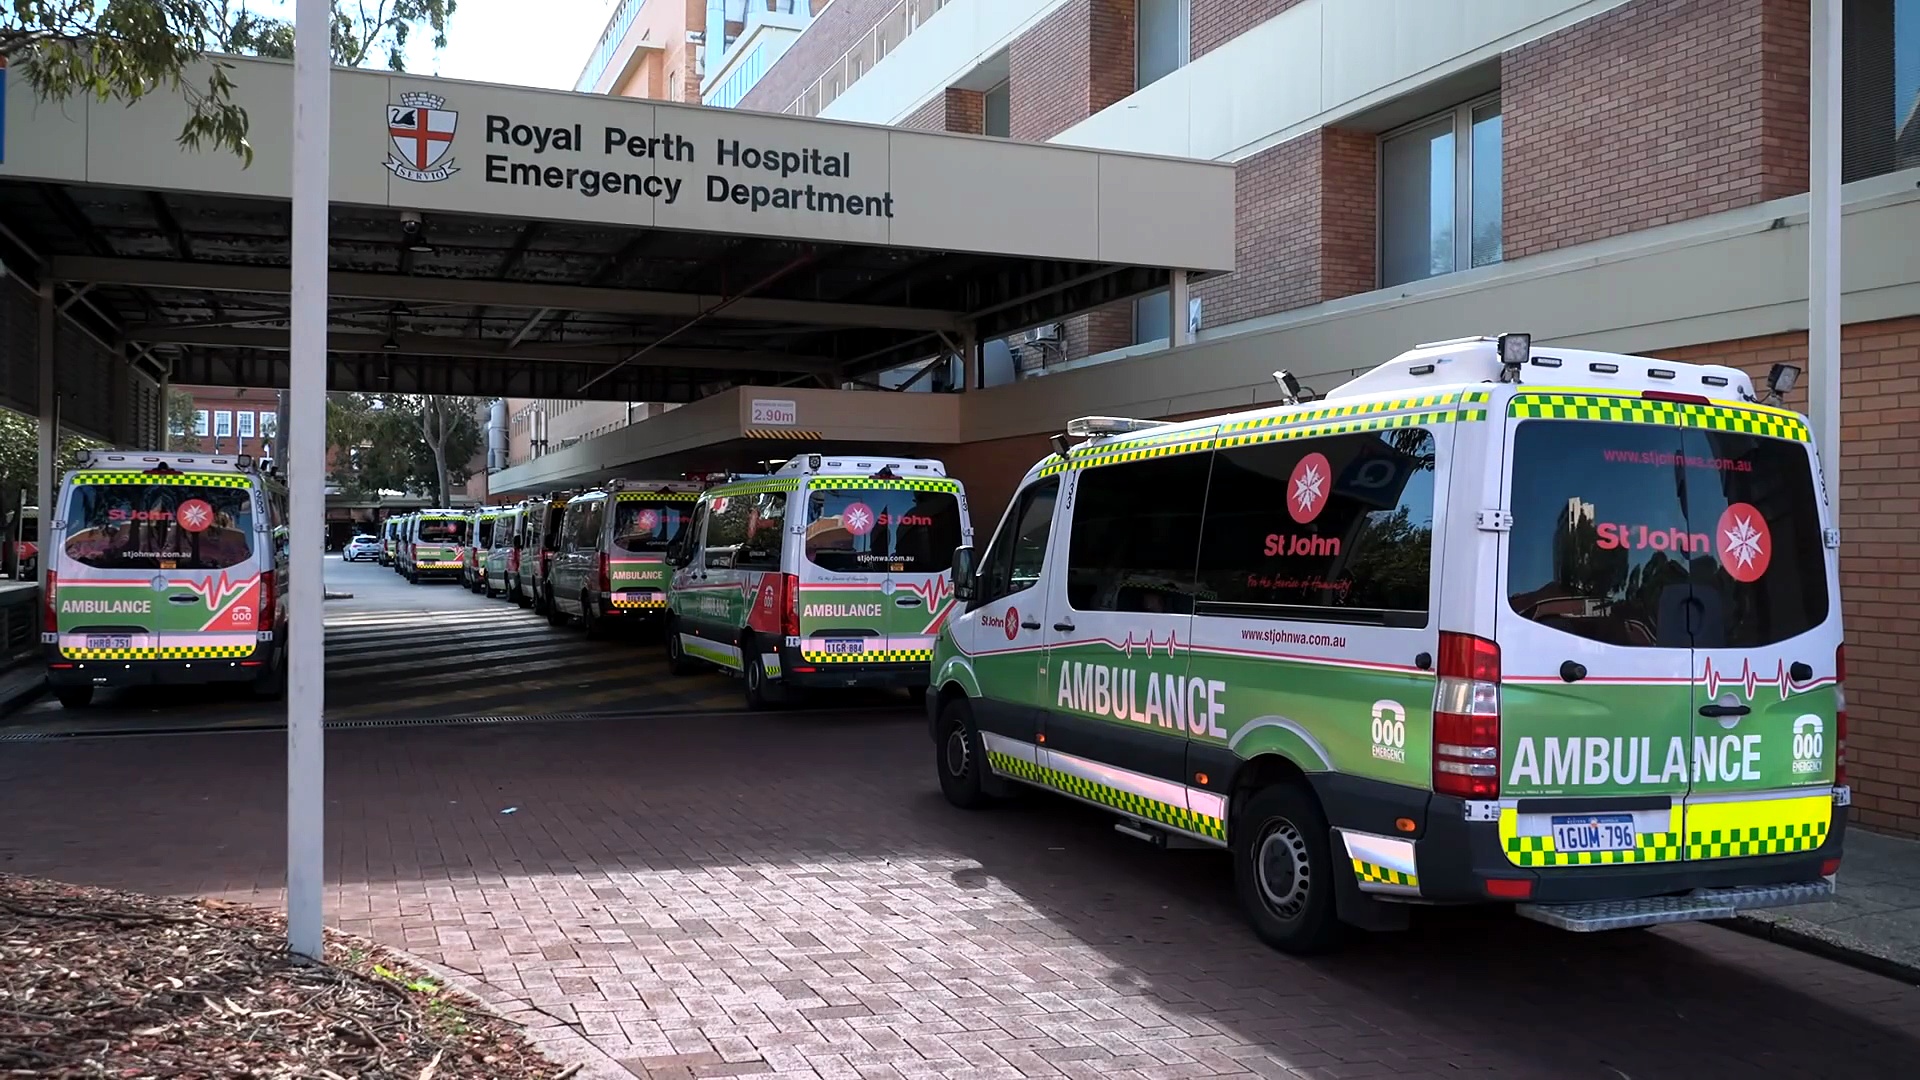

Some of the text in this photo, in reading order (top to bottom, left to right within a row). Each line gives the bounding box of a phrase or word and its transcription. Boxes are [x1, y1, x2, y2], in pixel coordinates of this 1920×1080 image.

[486, 115, 850, 178] Royal Perth Hospital
[399, 169, 445, 180] SERVIO
[485, 154, 894, 218] Emergency Department
[753, 409, 794, 422] 2.90m
[1604, 449, 1752, 472] www.stjohnwa.com.au
[108, 509, 174, 520] St John
[878, 514, 932, 526] St John
[1596, 523, 1710, 552] St John
[1263, 534, 1340, 556] St John
[122, 551, 192, 560] stjohnwa.com.au
[857, 554, 915, 563] stjohnwa.com.au
[612, 571, 663, 580] AMBULANCE
[61, 600, 151, 613] AMBULANCE
[803, 604, 882, 617] AMBULANCE
[232, 613, 252, 621] 000
[988, 616, 1004, 628] John
[1241, 628, 1346, 648] www.stjohnwa.com.au
[1057, 660, 1228, 739] AMBULANCE
[1371, 718, 1405, 748] 000
[1372, 745, 1405, 761] EMERGENCY
[1793, 733, 1823, 759] 000
[1508, 735, 1762, 785] AMBULANCE
